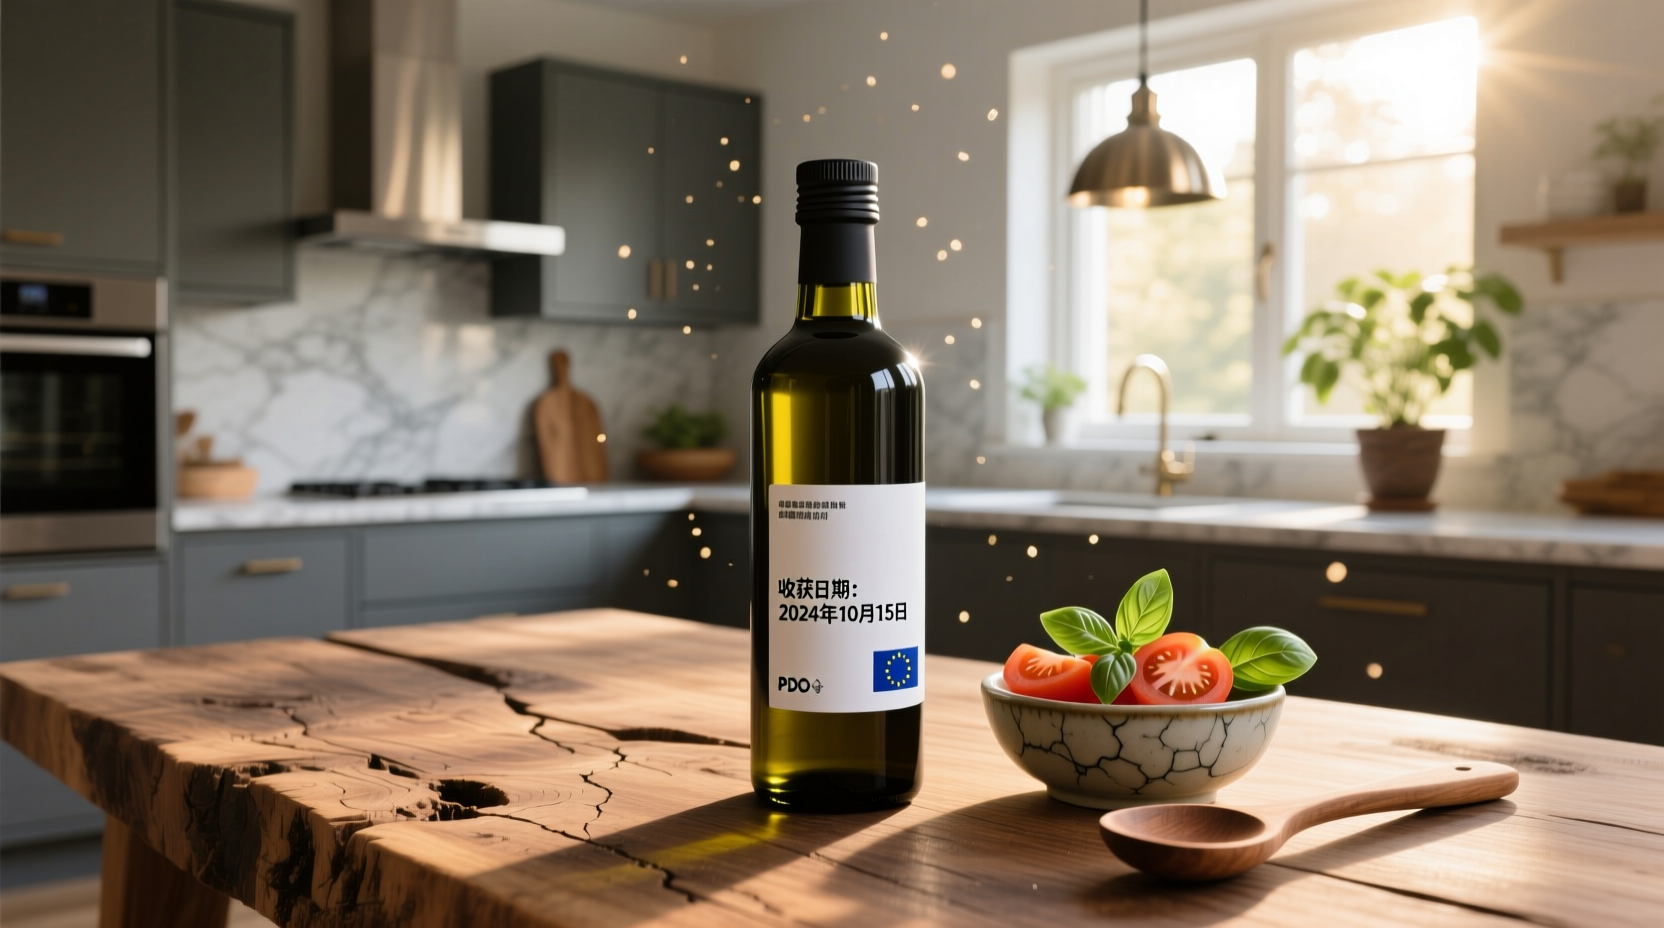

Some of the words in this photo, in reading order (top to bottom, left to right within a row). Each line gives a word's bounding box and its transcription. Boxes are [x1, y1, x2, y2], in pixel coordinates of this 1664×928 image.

[778, 602, 907, 624] 2024年10月15日
[778, 676, 811, 693] PDO
